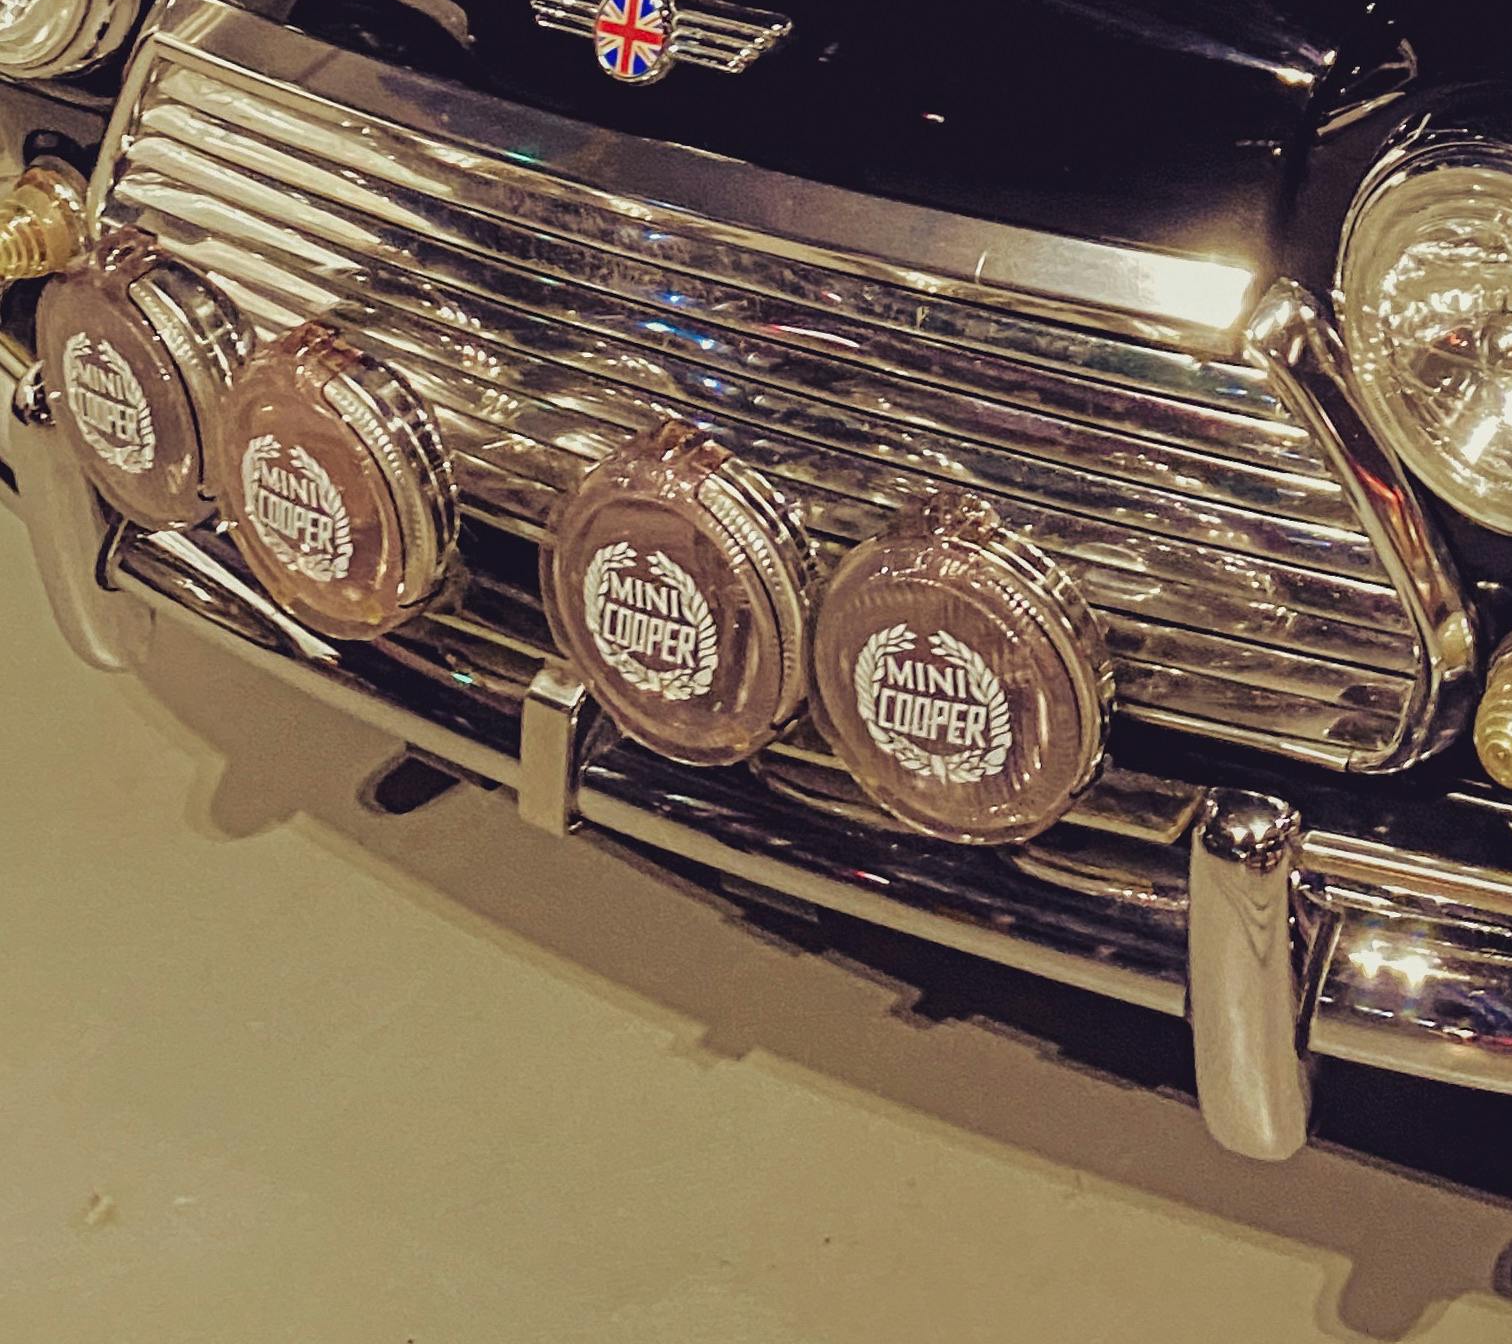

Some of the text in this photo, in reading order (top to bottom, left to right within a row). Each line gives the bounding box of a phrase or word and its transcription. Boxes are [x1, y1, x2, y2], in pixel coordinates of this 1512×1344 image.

[261, 460, 318, 508] MINI
[257, 487, 334, 554] COOPER
[609, 570, 680, 618] MINI
[602, 601, 696, 668] COOPER
[886, 655, 967, 699] MINI
[878, 687, 988, 748] COOPER
